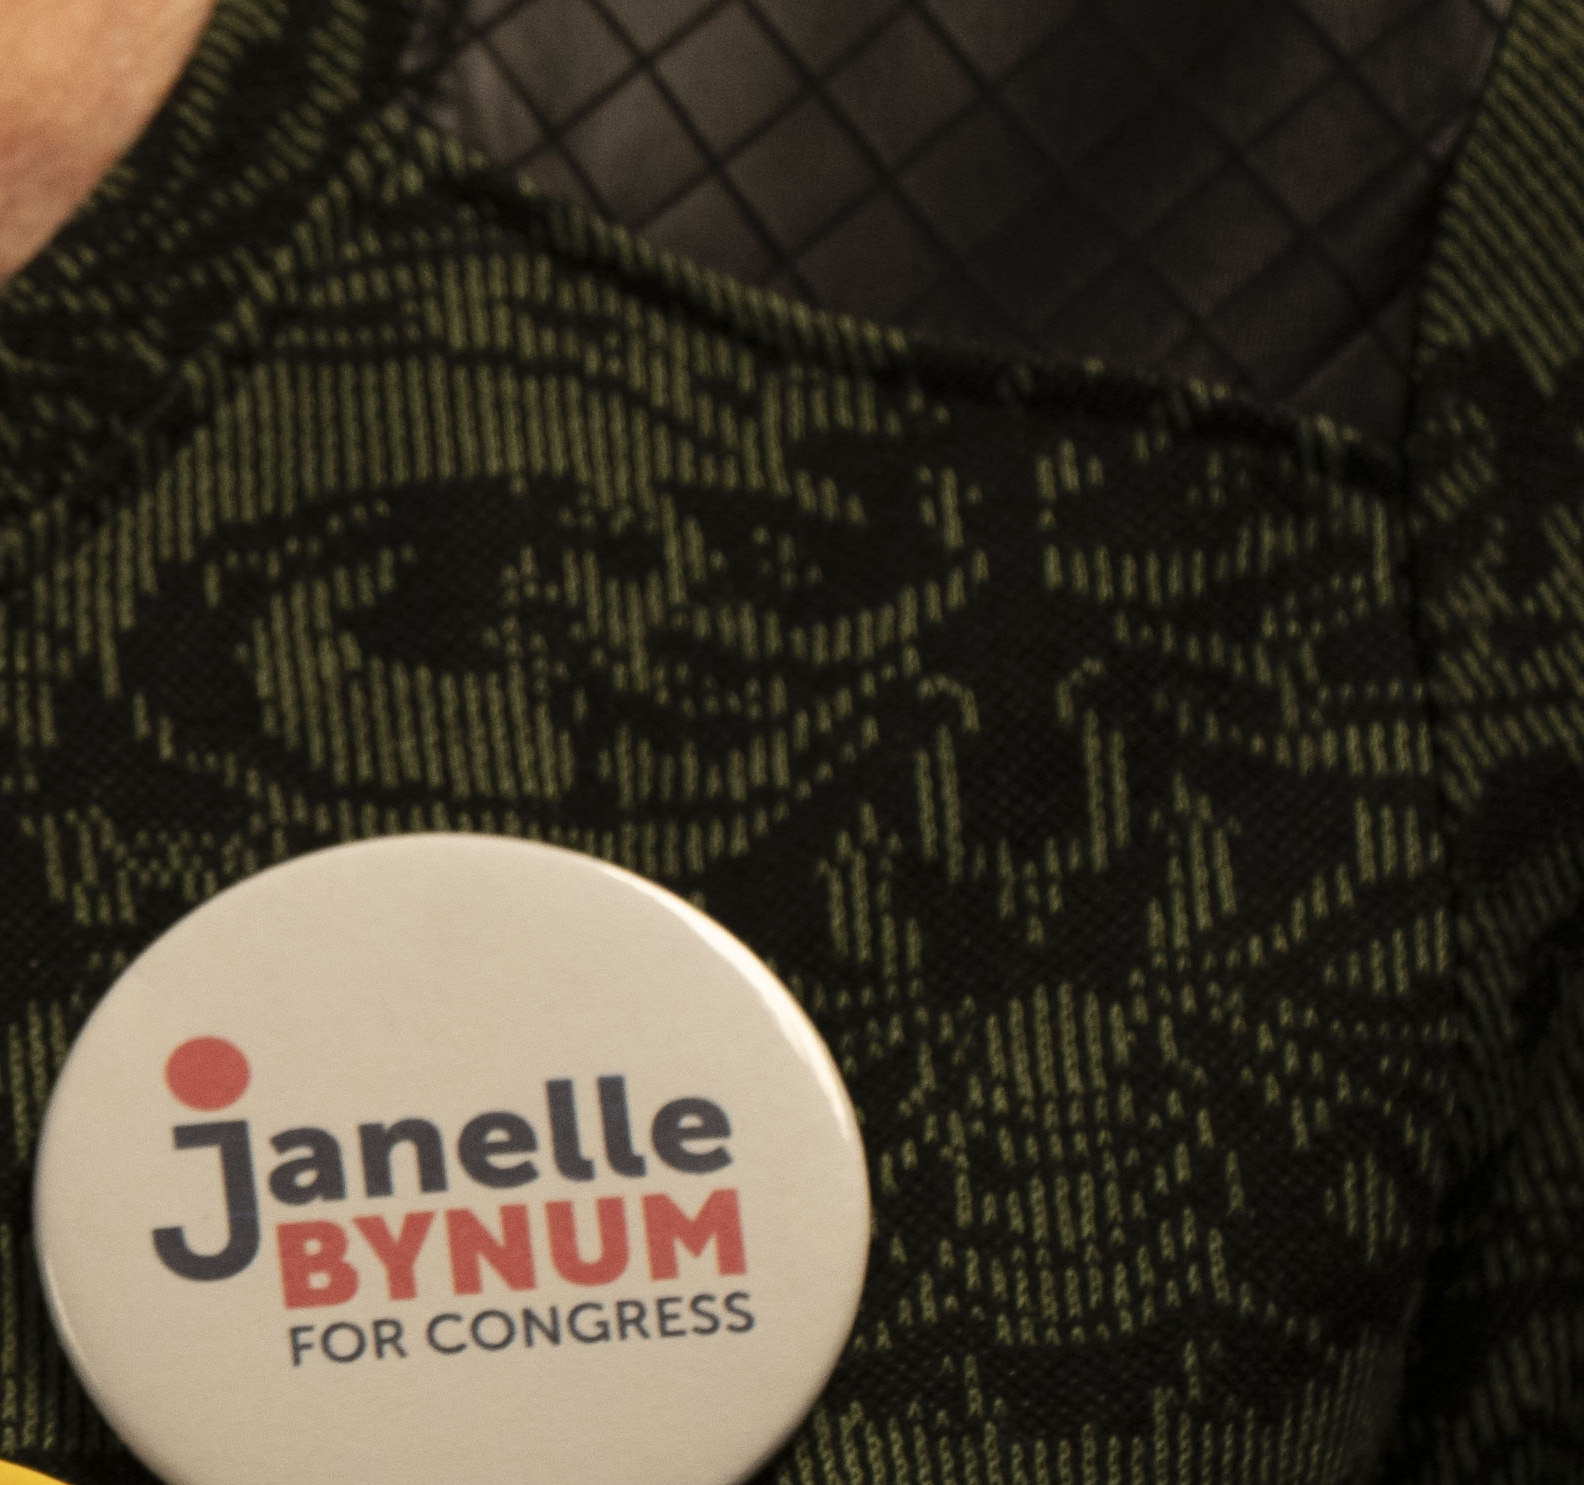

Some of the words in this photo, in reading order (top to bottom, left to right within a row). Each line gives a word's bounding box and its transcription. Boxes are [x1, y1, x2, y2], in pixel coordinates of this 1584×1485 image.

[150, 1035, 734, 1283] janelle
[274, 1187, 749, 1311] BYNUM
[287, 1317, 408, 1368] FOR
[425, 1290, 757, 1357] CONGRESS
